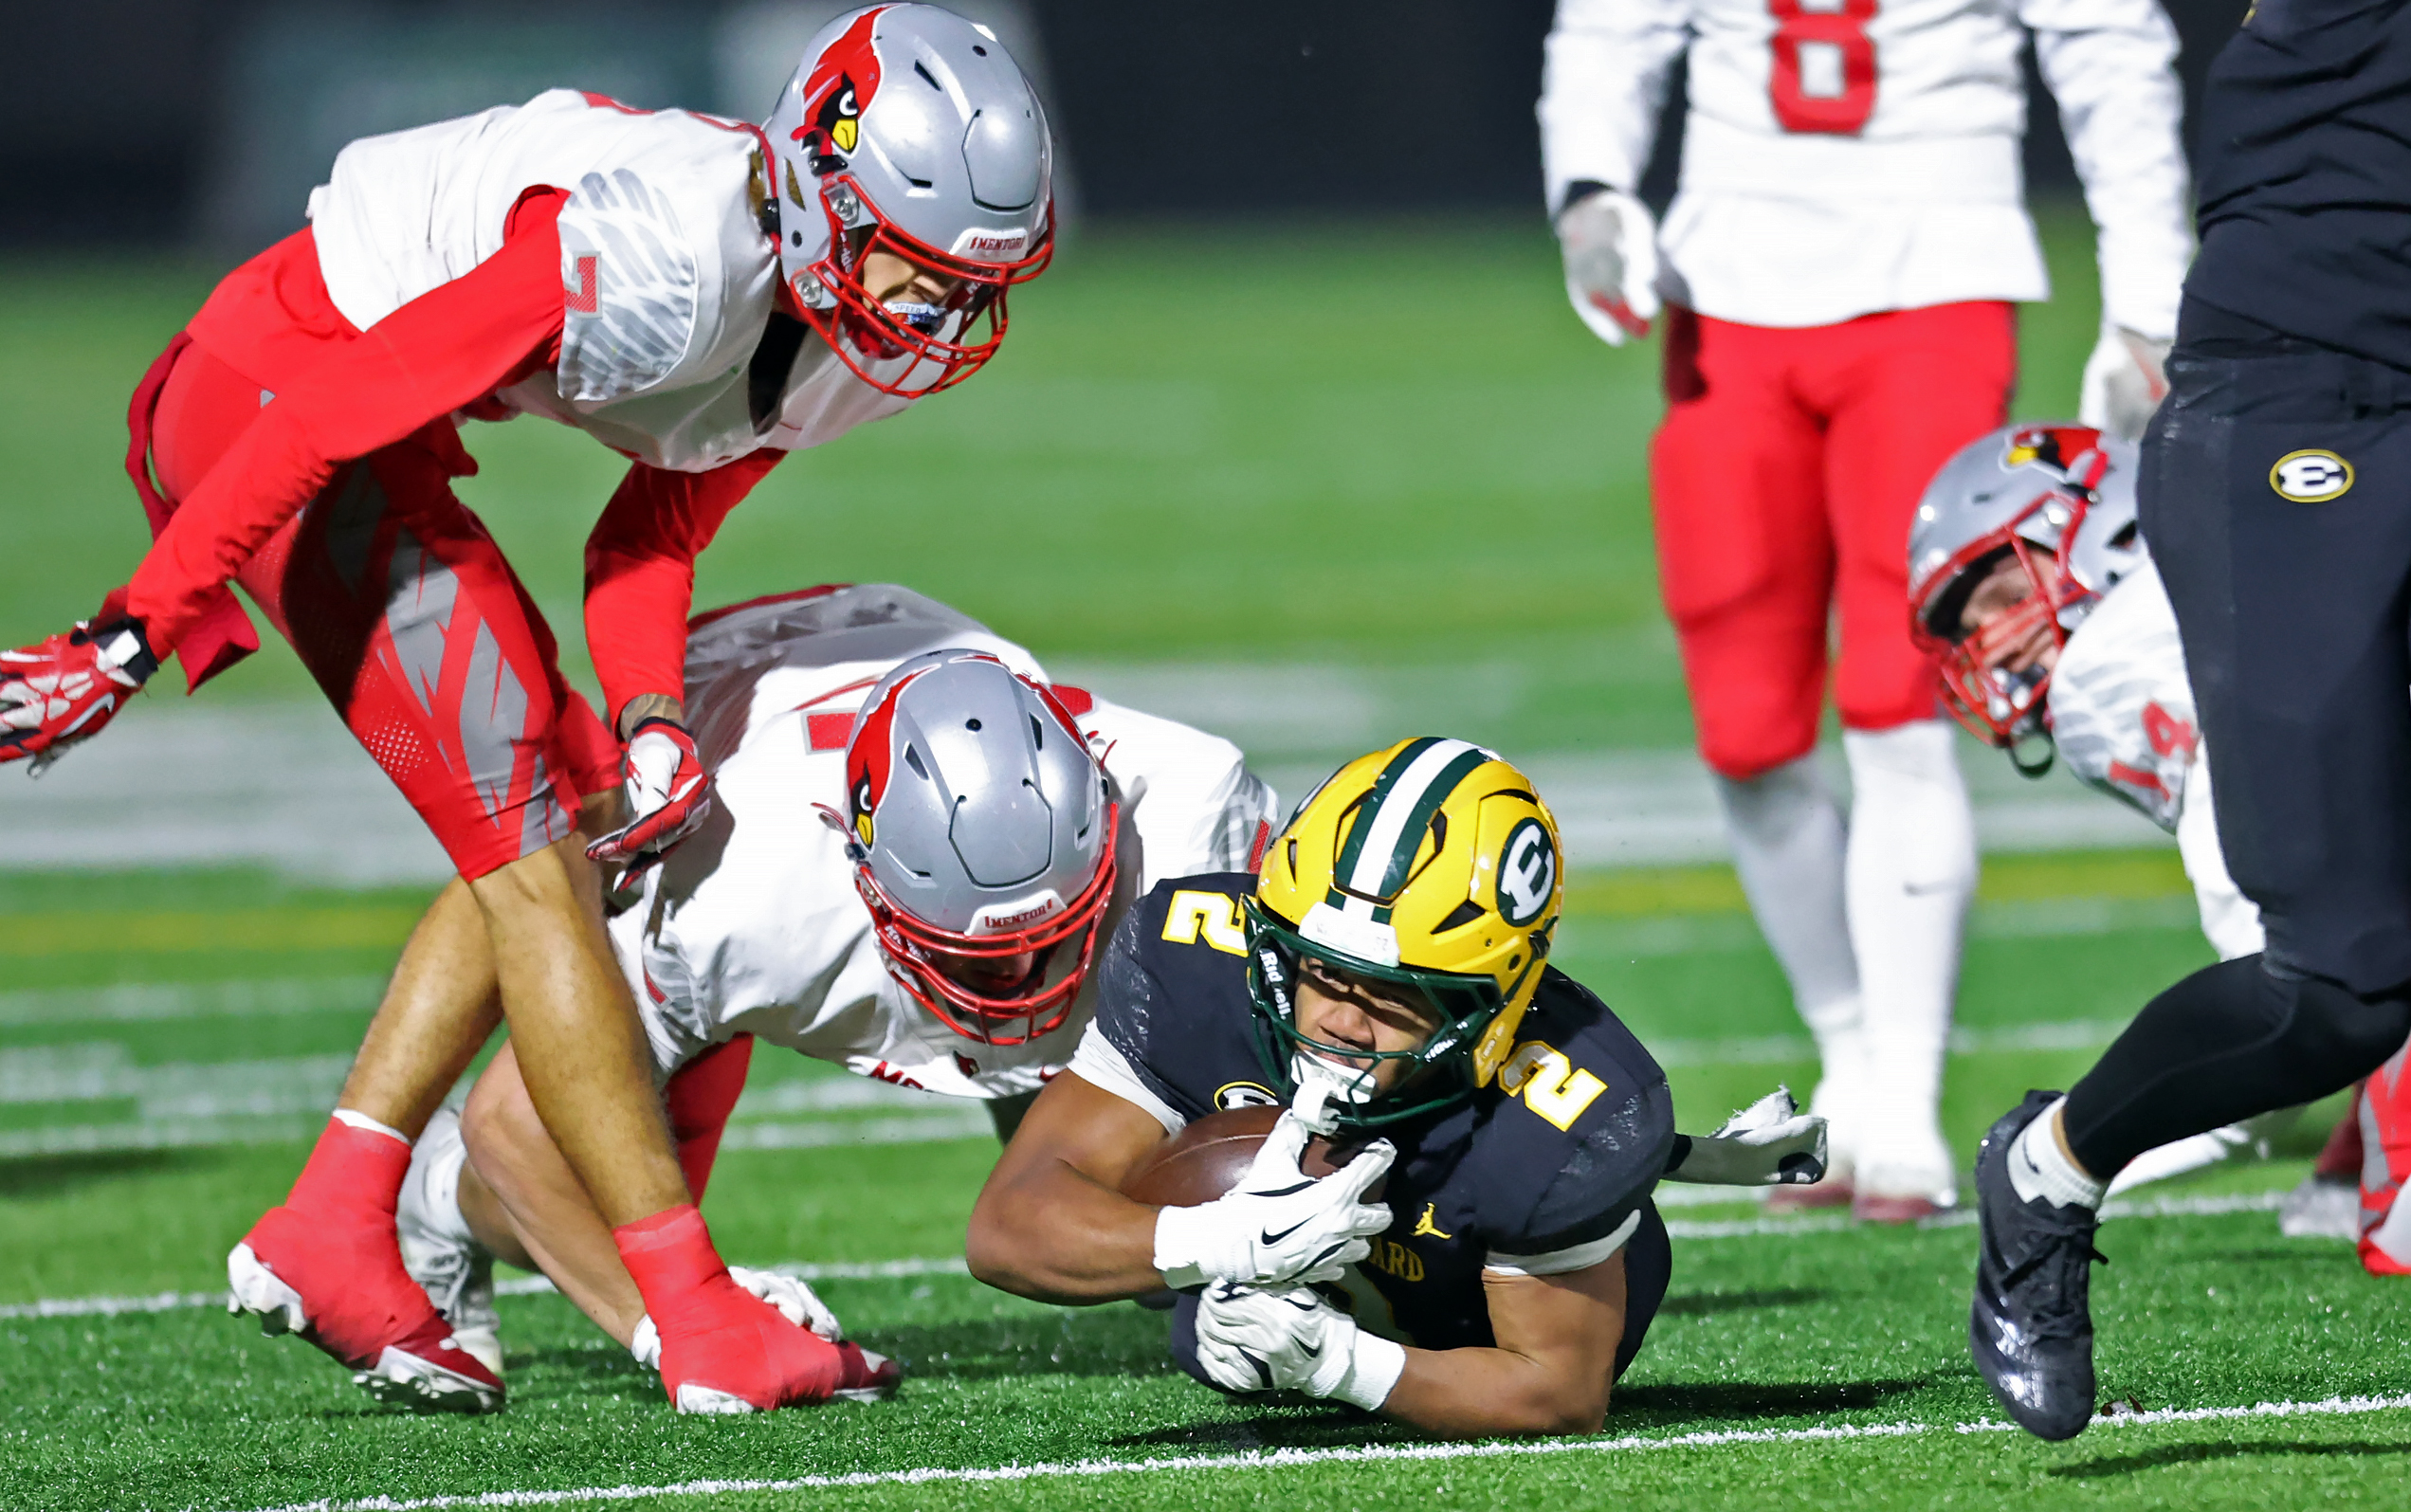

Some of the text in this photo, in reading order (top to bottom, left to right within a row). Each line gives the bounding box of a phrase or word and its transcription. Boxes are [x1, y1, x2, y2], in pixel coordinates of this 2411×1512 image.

[2275, 454, 2348, 498] E
[1499, 822, 1555, 921] E
[1160, 889, 1250, 958] 2
[1259, 950, 1292, 1016] Ridell
[1498, 1040, 1609, 1133] 2
[1368, 1235, 1425, 1282] ARD
